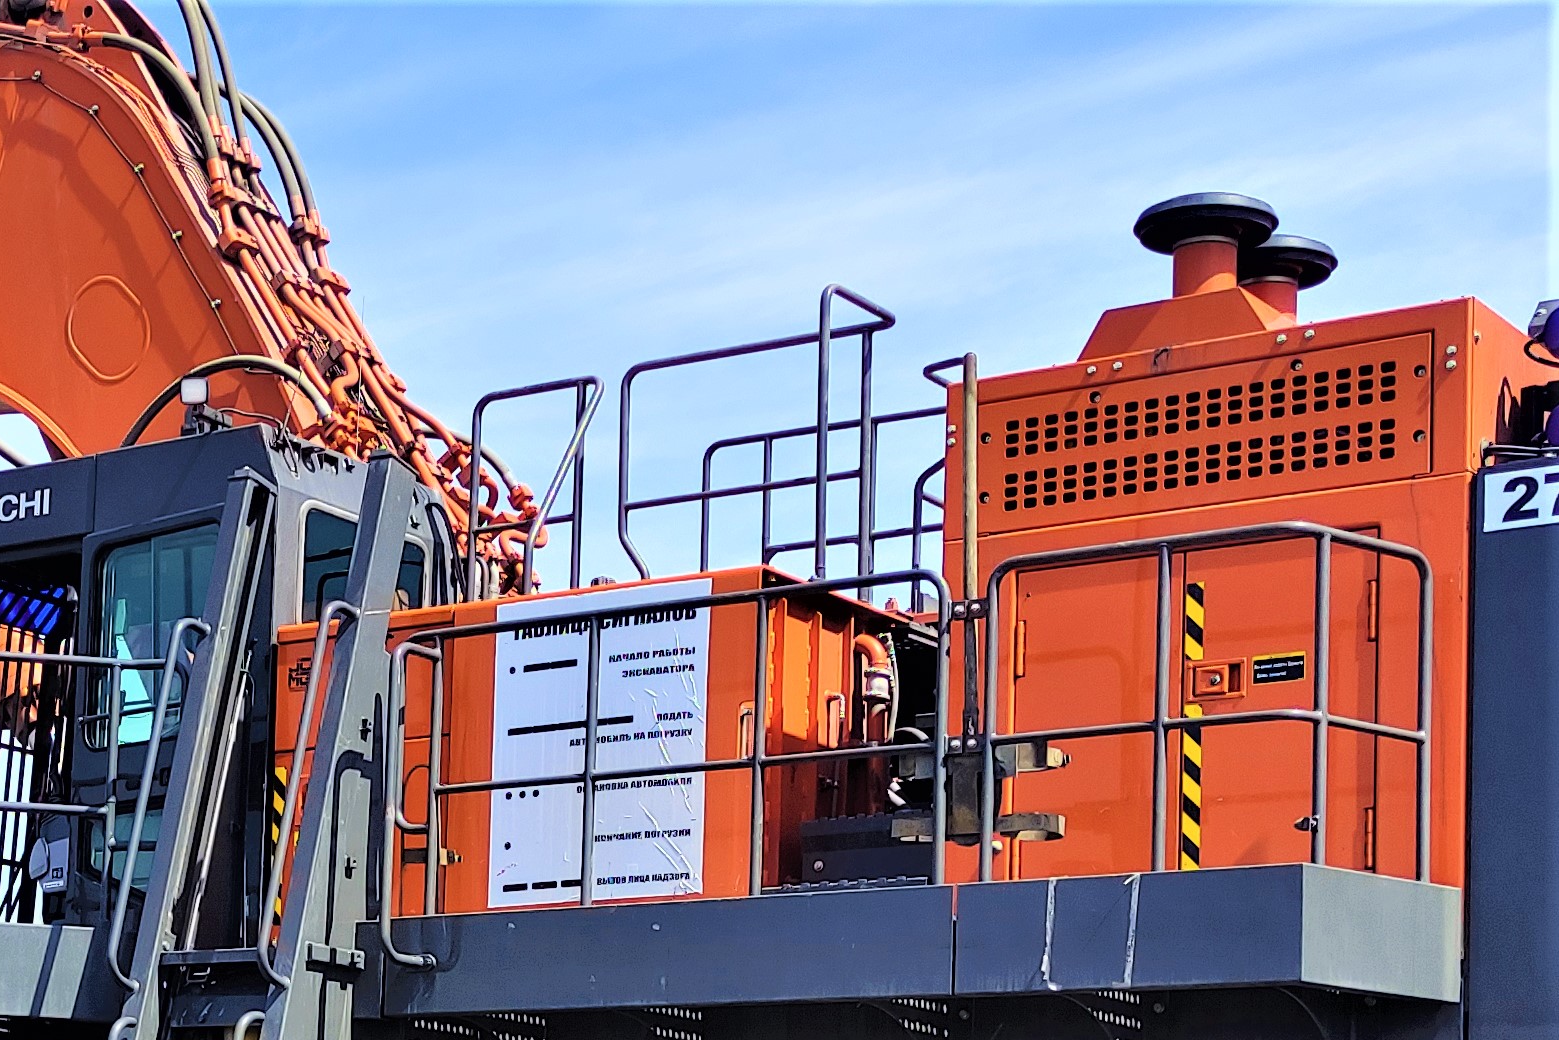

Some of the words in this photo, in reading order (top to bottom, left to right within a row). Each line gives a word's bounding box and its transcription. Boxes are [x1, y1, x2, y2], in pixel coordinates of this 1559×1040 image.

[608, 650, 650, 663] НАЧАЛО
[652, 646, 696, 658] РАБОТЫ
[621, 663, 695, 678] ЭКСКАВАТОРА
[656, 711, 694, 722] ПОДАТЬ
[569, 733, 631, 747] АВТОБИЛЬ
[633, 731, 646, 741] НА
[594, 831, 642, 843] КОНЧАНИЕ
[627, 874, 650, 884] ЛИЦА
[651, 872, 690, 883] НАДЗОРА
